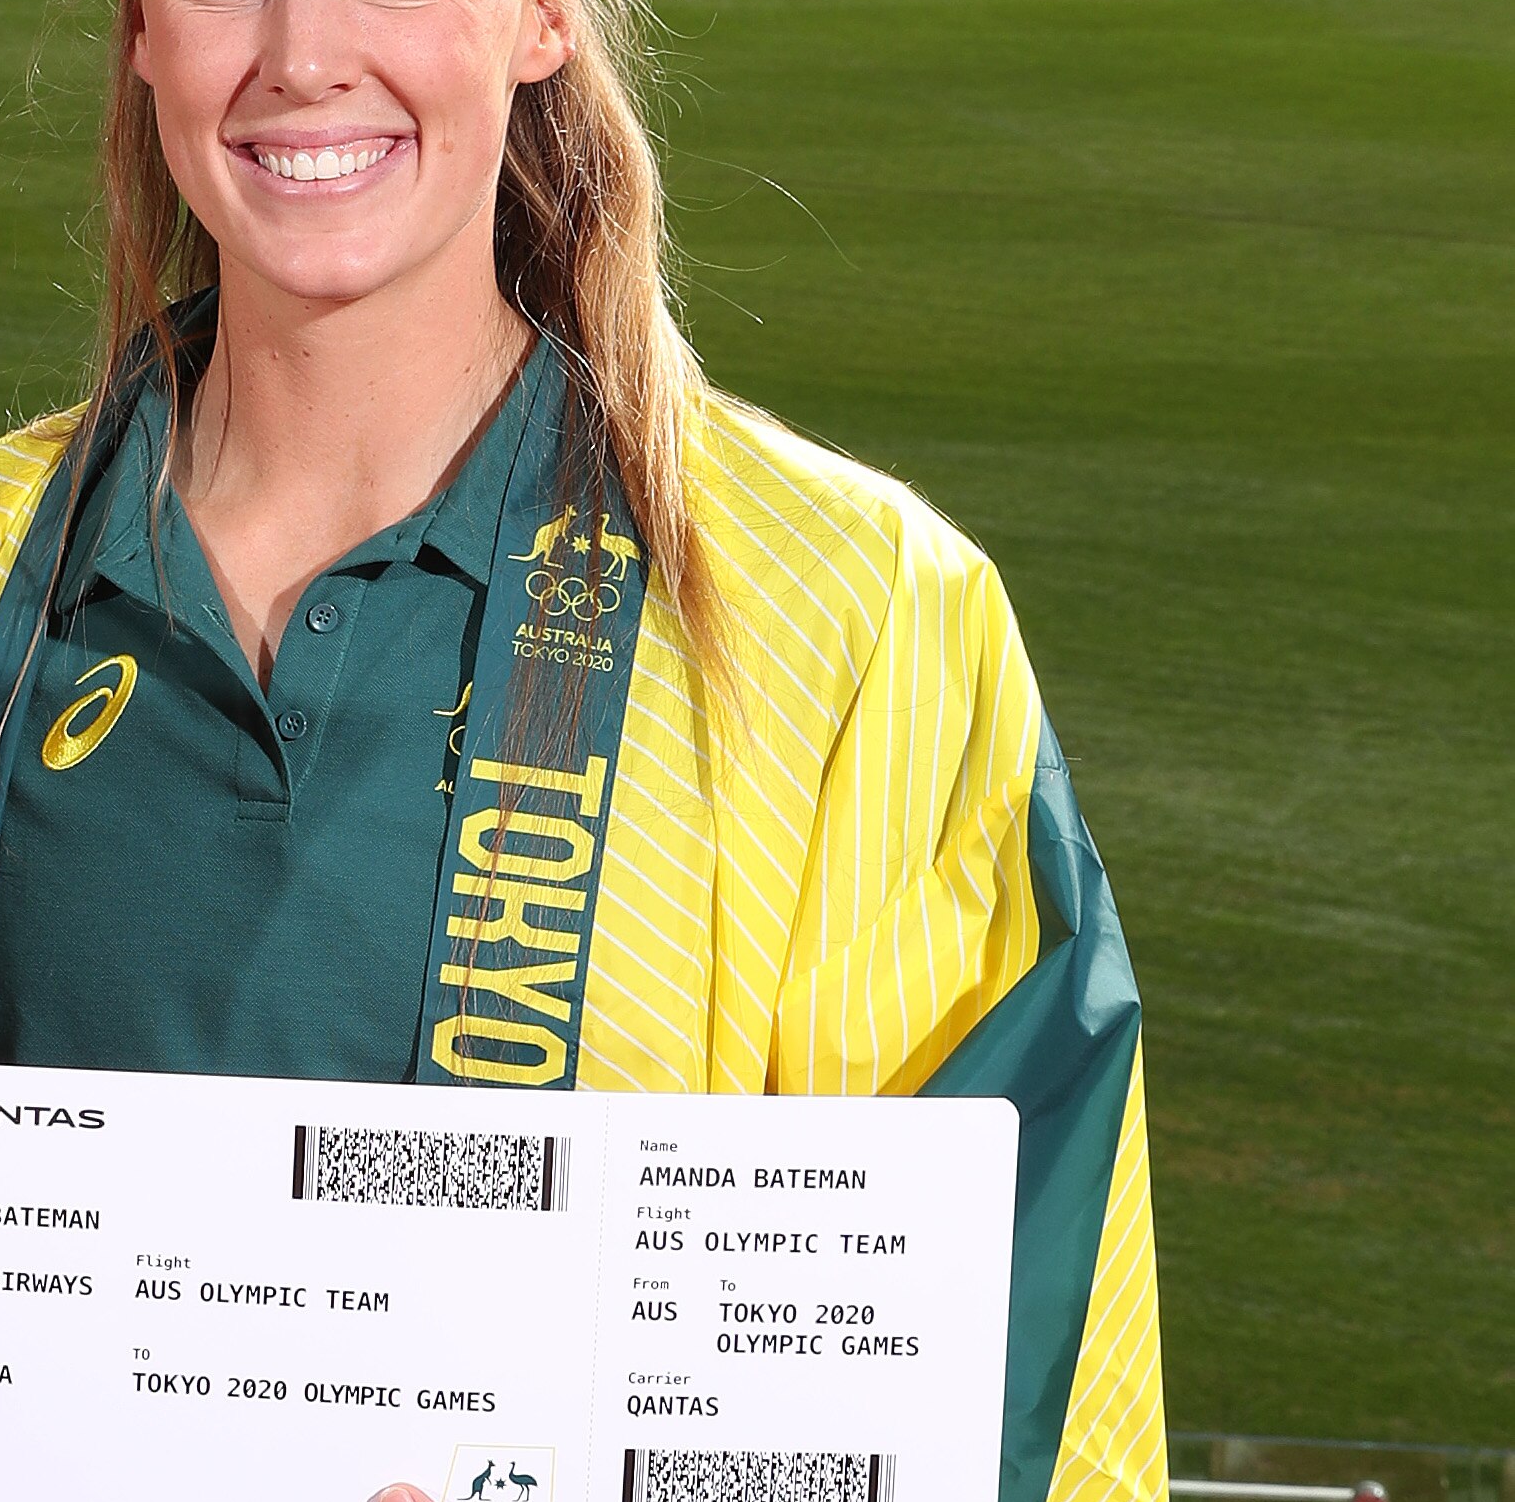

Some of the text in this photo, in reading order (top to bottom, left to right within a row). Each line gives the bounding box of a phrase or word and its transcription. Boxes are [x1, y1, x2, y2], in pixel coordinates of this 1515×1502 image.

[511, 640, 615, 672] TOKYO 2020
[431, 755, 607, 1086] TOKYO
[640, 1139, 678, 1153] Name
[639, 1166, 866, 1190] AMANDA BATEMAN
[638, 1206, 691, 1223] Flight
[635, 1230, 906, 1255] AUS OLYMPIC TEAM
[136, 1254, 191, 1271] Flight
[134, 1278, 389, 1313] AUS OLYMPIC TEAM
[633, 1277, 670, 1290] From
[720, 1279, 736, 1292] To
[631, 1300, 678, 1322] AUS
[718, 1302, 875, 1326] TOKYO 2020
[716, 1333, 919, 1357] OLYMPIC GAMES
[628, 1371, 691, 1385] Carrier
[132, 1372, 496, 1413] TOKYO 2020 OLYMPIC GAMES
[626, 1394, 719, 1418] QANTAS
